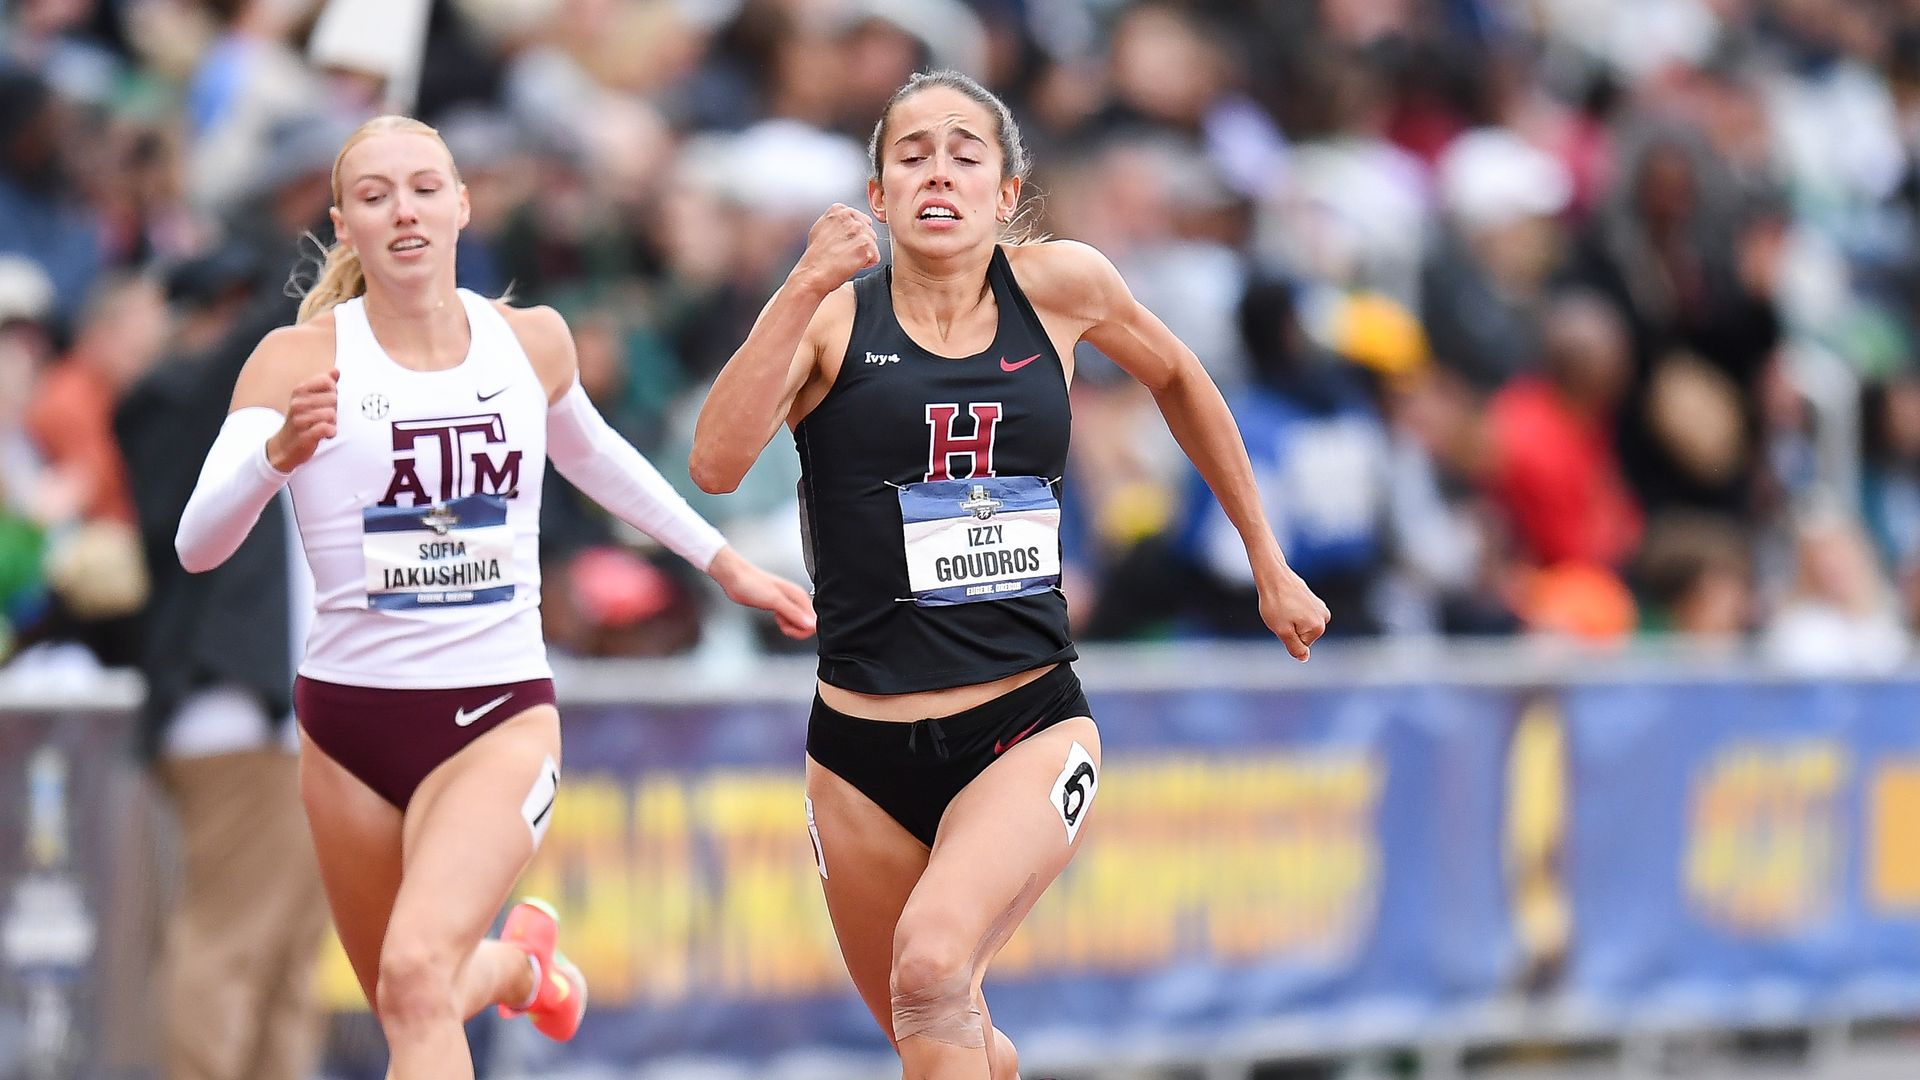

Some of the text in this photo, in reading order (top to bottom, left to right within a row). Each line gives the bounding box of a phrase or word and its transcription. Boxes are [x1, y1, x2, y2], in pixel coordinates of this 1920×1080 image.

[864, 351, 888, 366] Ivy
[924, 402, 1003, 483] H
[967, 524, 1003, 547] IZZY
[419, 541, 467, 560] SOFIA
[384, 558, 501, 589] IAKUSHINA
[935, 546, 1040, 583] GOUDROS
